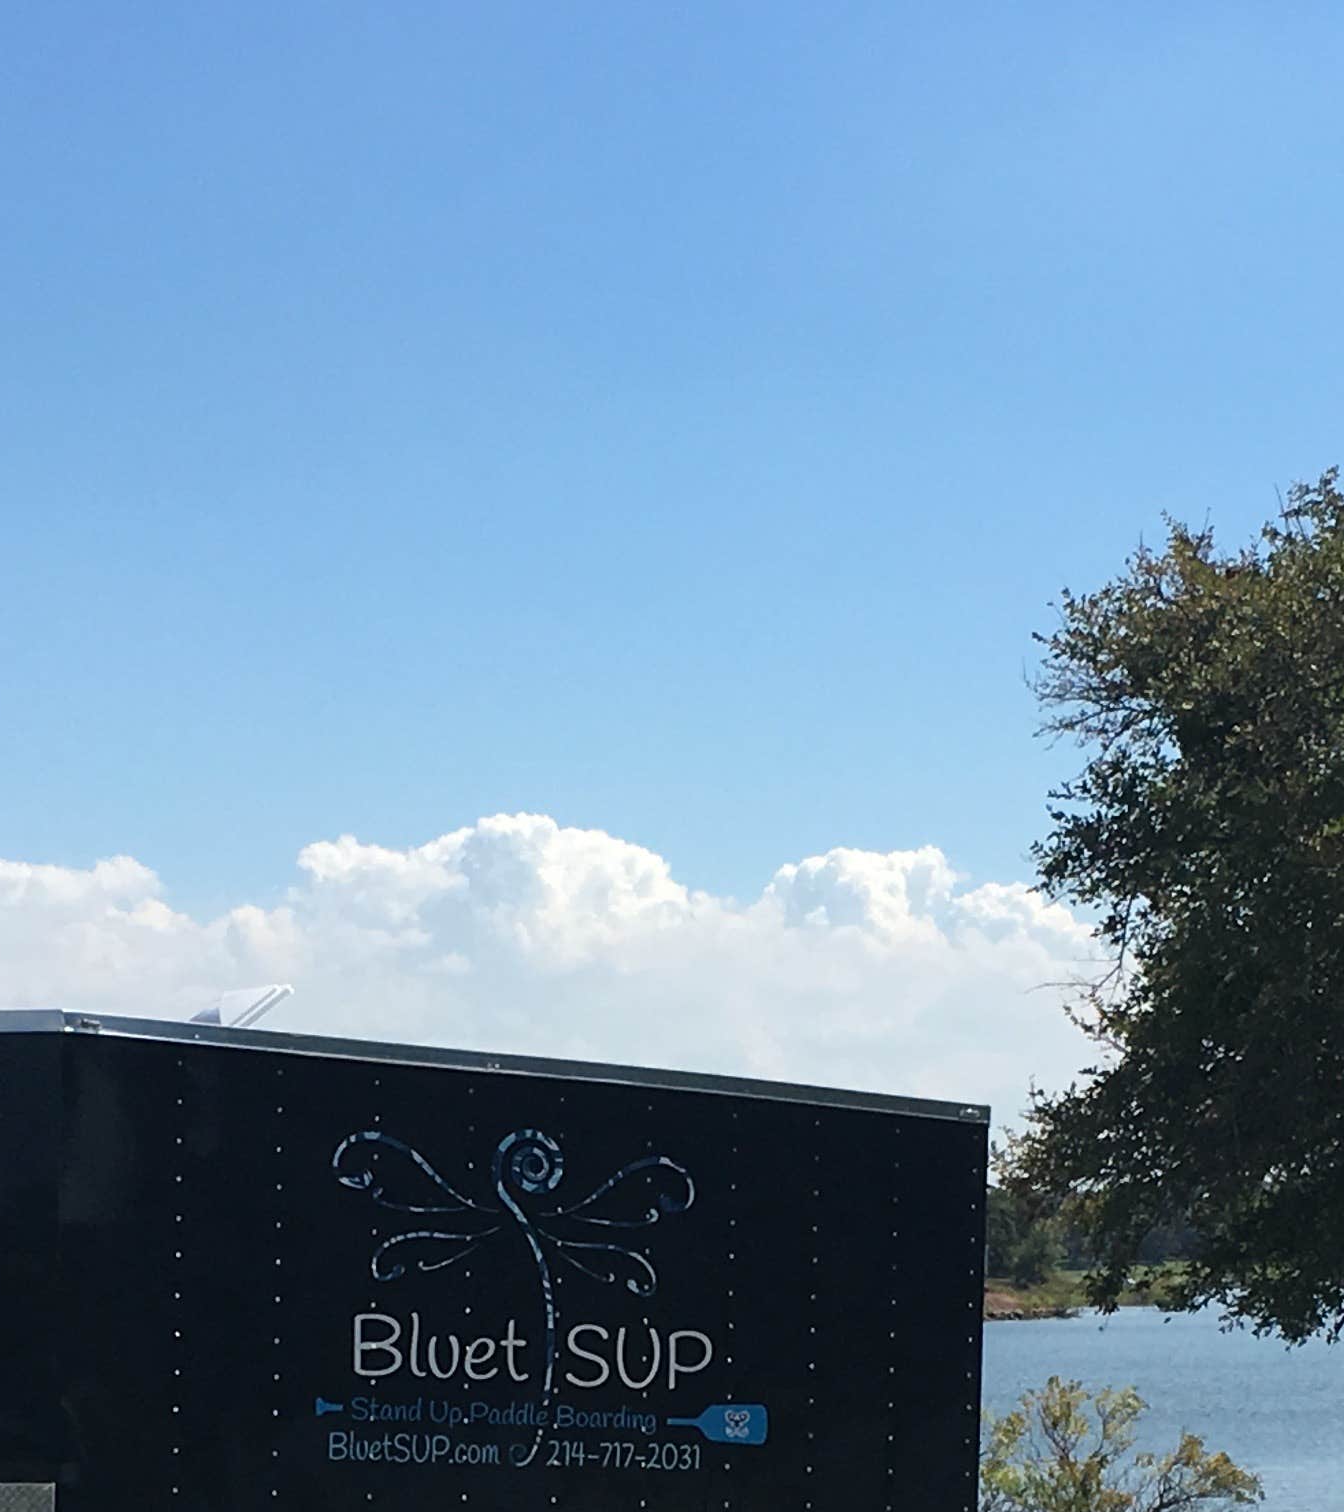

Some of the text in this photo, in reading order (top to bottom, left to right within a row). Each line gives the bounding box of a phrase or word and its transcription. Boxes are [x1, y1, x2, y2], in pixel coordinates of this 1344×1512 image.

[354, 1312, 713, 1390] Bluet SUP
[351, 1397, 657, 1435] Stand Up Paddle Boarding
[329, 1431, 701, 1469] BluetSUP.com 214-717-2031
